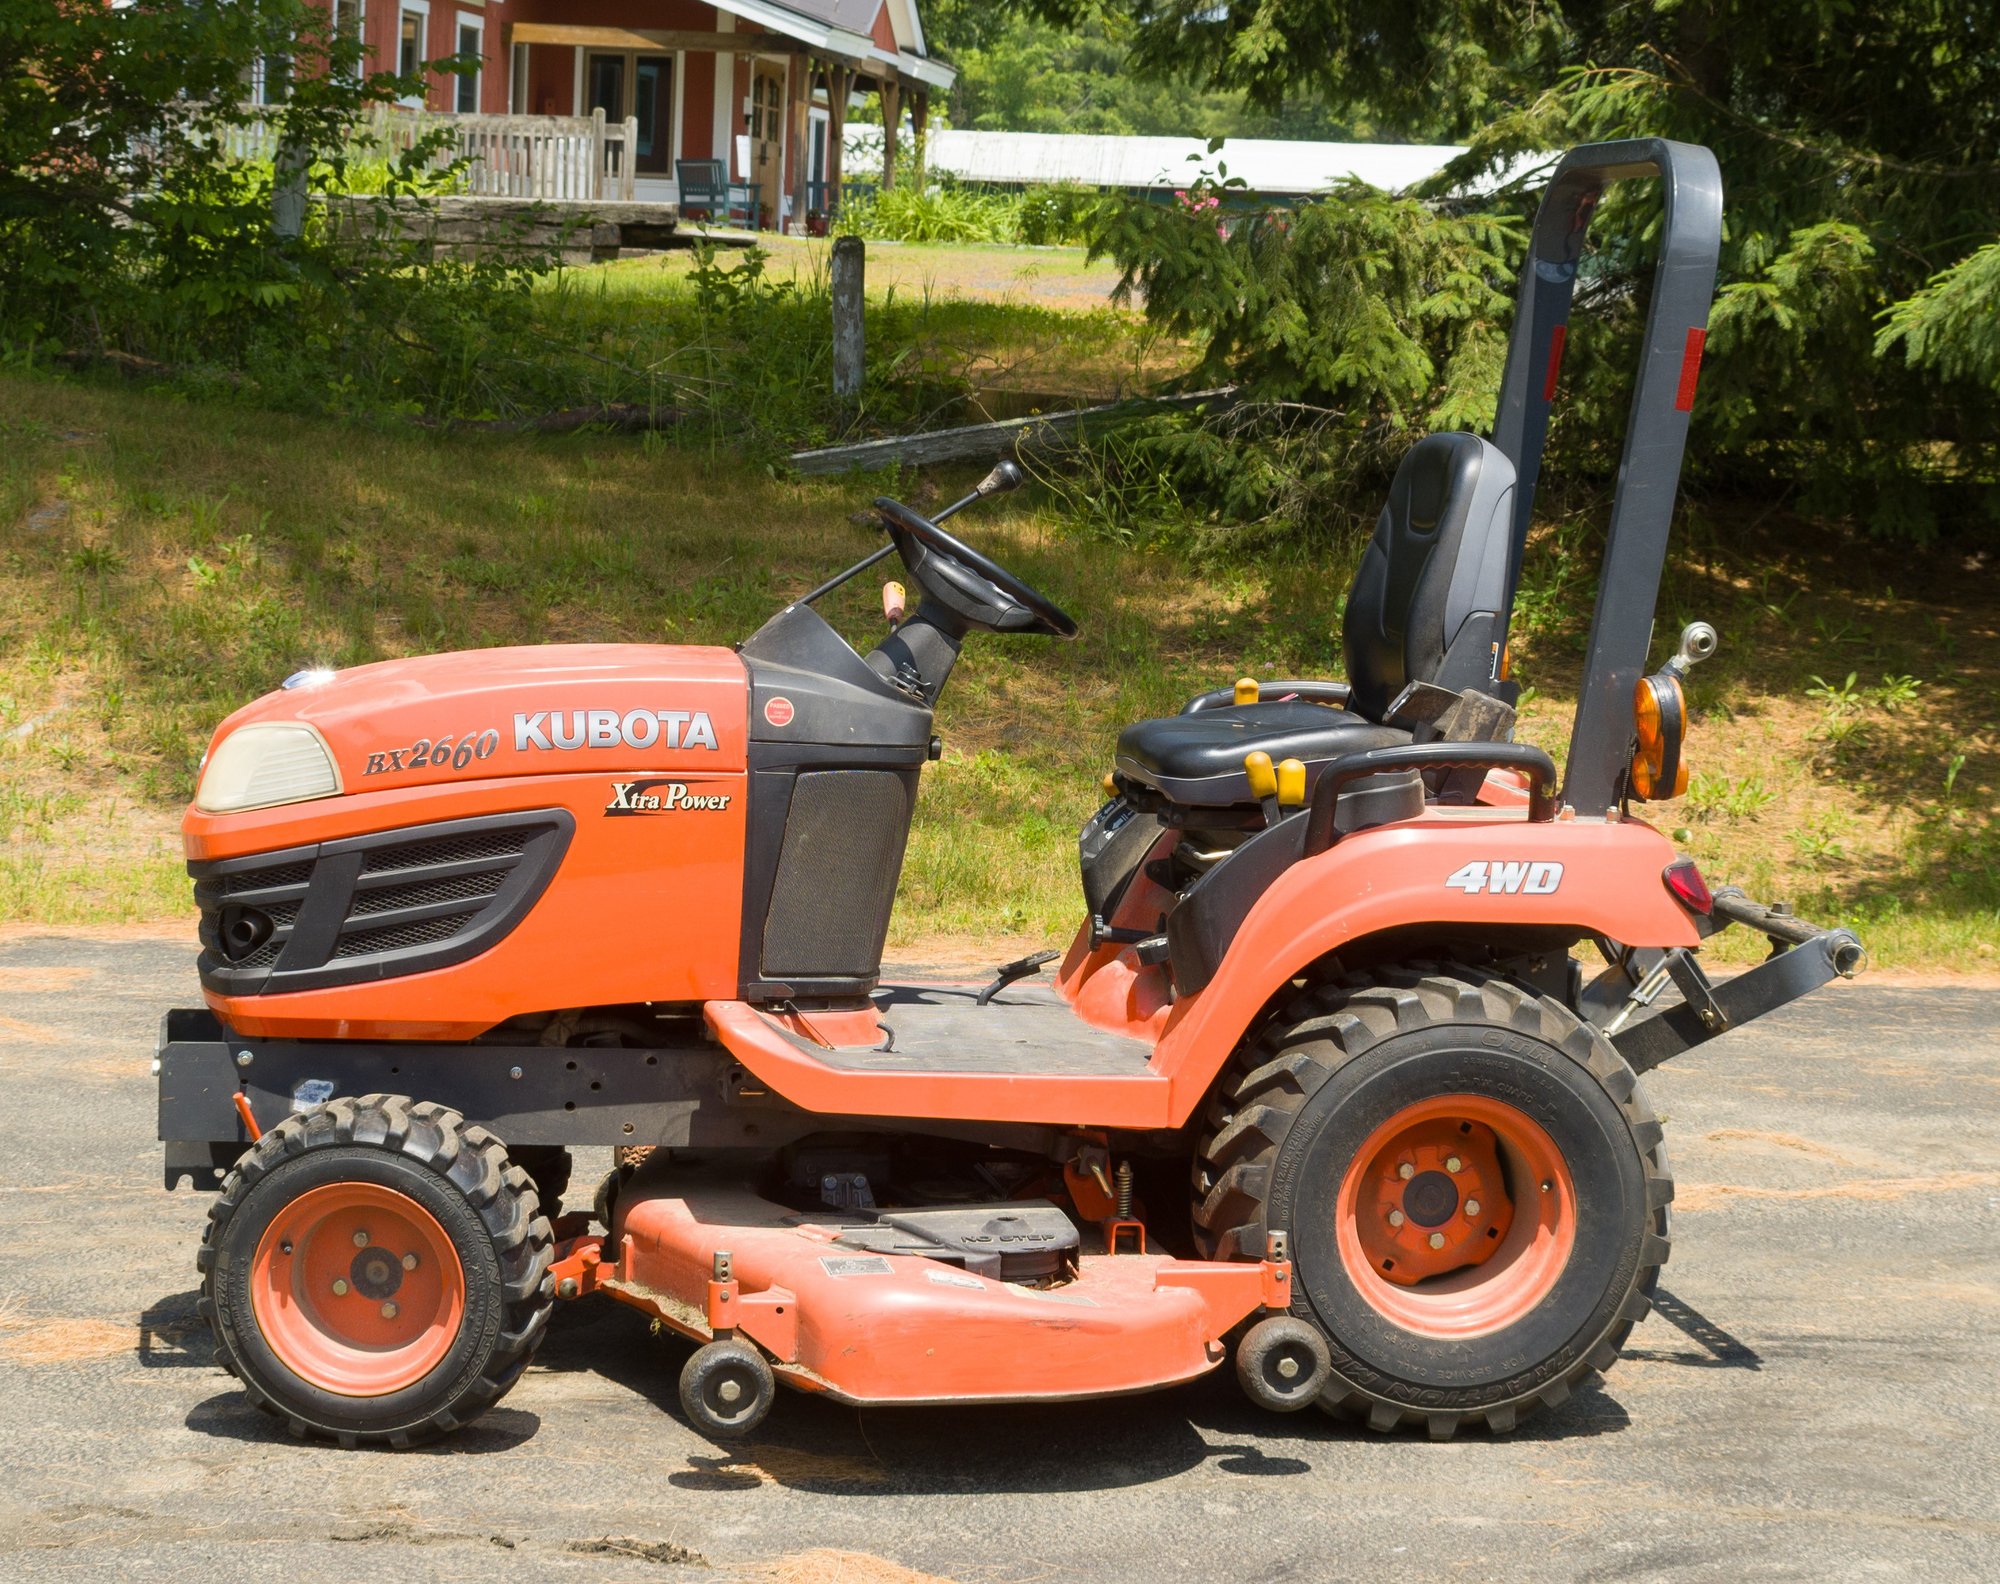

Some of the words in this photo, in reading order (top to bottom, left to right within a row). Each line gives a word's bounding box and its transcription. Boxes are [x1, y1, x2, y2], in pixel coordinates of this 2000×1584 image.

[513, 708, 719, 750] KUBOTA
[362, 728, 499, 776] BX2660
[605, 783, 659, 810] Xtra
[662, 783, 730, 810] Power
[1445, 861, 1564, 895] 4WD
[1481, 1029, 1555, 1070] OTR
[1380, 1345, 1577, 1407] TRACTION
[1393, 1357, 1428, 1379] CALL
[1435, 1363, 1493, 1380] SERVICE
